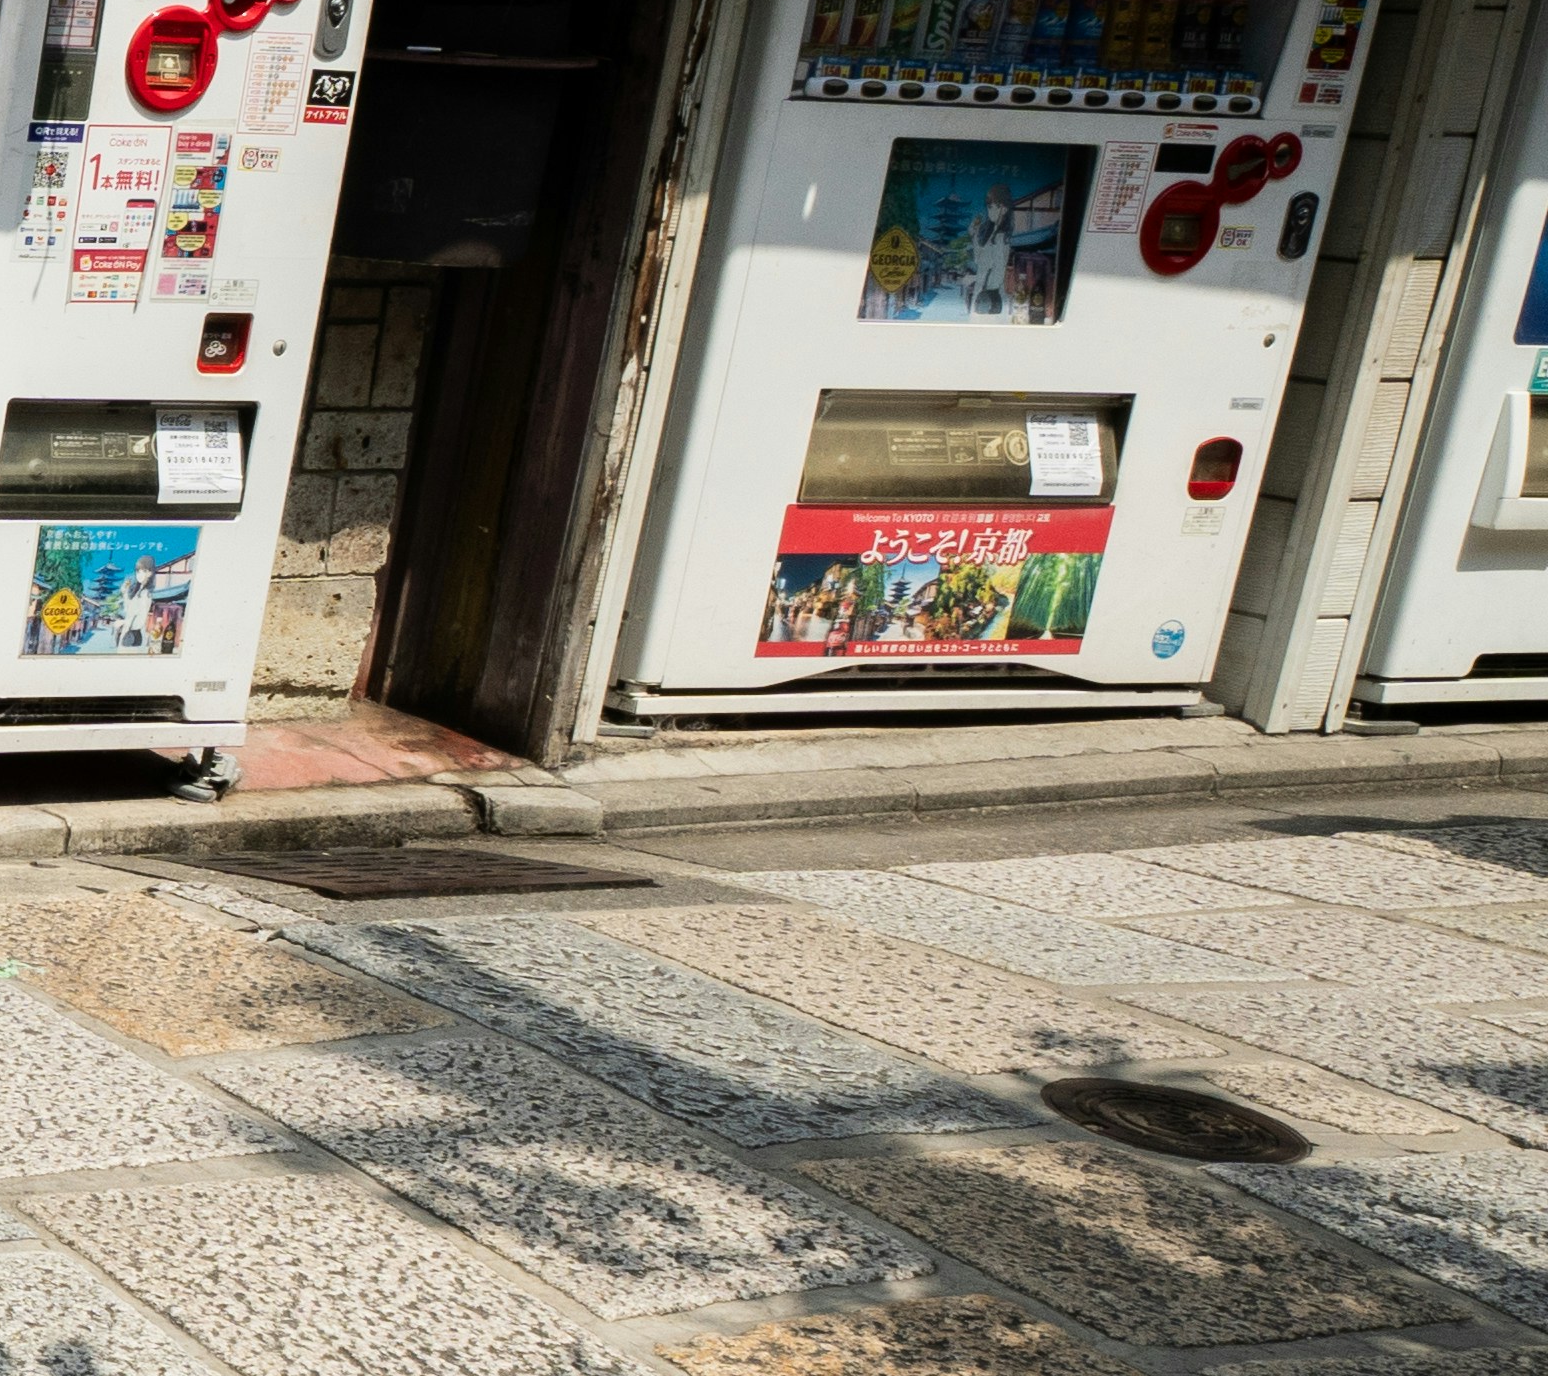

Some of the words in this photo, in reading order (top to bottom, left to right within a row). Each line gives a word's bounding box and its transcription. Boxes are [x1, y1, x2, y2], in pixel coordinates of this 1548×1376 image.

[109, 138, 132, 148] Coke
[260, 160, 274, 169] OK
[89, 153, 161, 192] 1本無料!
[871, 254, 916, 266] GEORGIA
[93, 260, 113, 269] Coke
[126, 261, 141, 271] Pay
[853, 513, 891, 523] Welcome
[892, 513, 903, 523] To
[903, 513, 935, 523] KYOTO
[860, 527, 1034, 565] ようこそ!京都
[43, 607, 80, 617] GEORGIA
